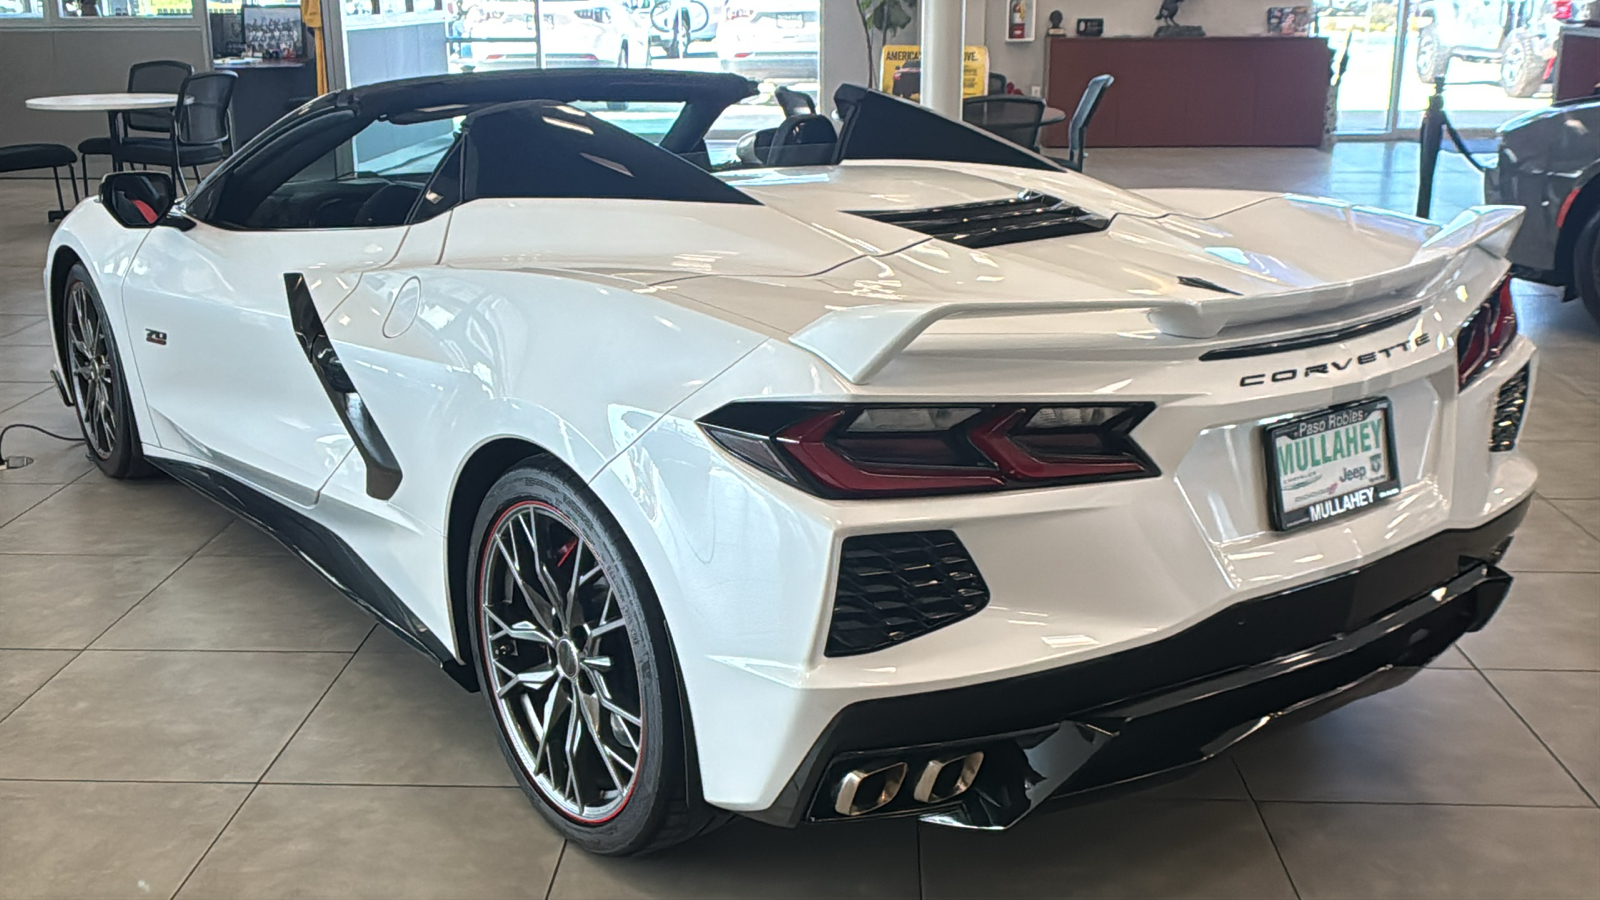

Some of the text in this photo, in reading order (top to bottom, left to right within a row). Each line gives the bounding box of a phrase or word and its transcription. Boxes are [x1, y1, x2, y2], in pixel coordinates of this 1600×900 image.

[1240, 333, 1431, 388] CORVETTE
[1299, 421, 1326, 437] Paso
[1328, 410, 1364, 429] Robles
[1277, 418, 1383, 476] MULLAHEY
[1339, 466, 1367, 483] Jeep
[1309, 487, 1375, 522] MULLAHEY
